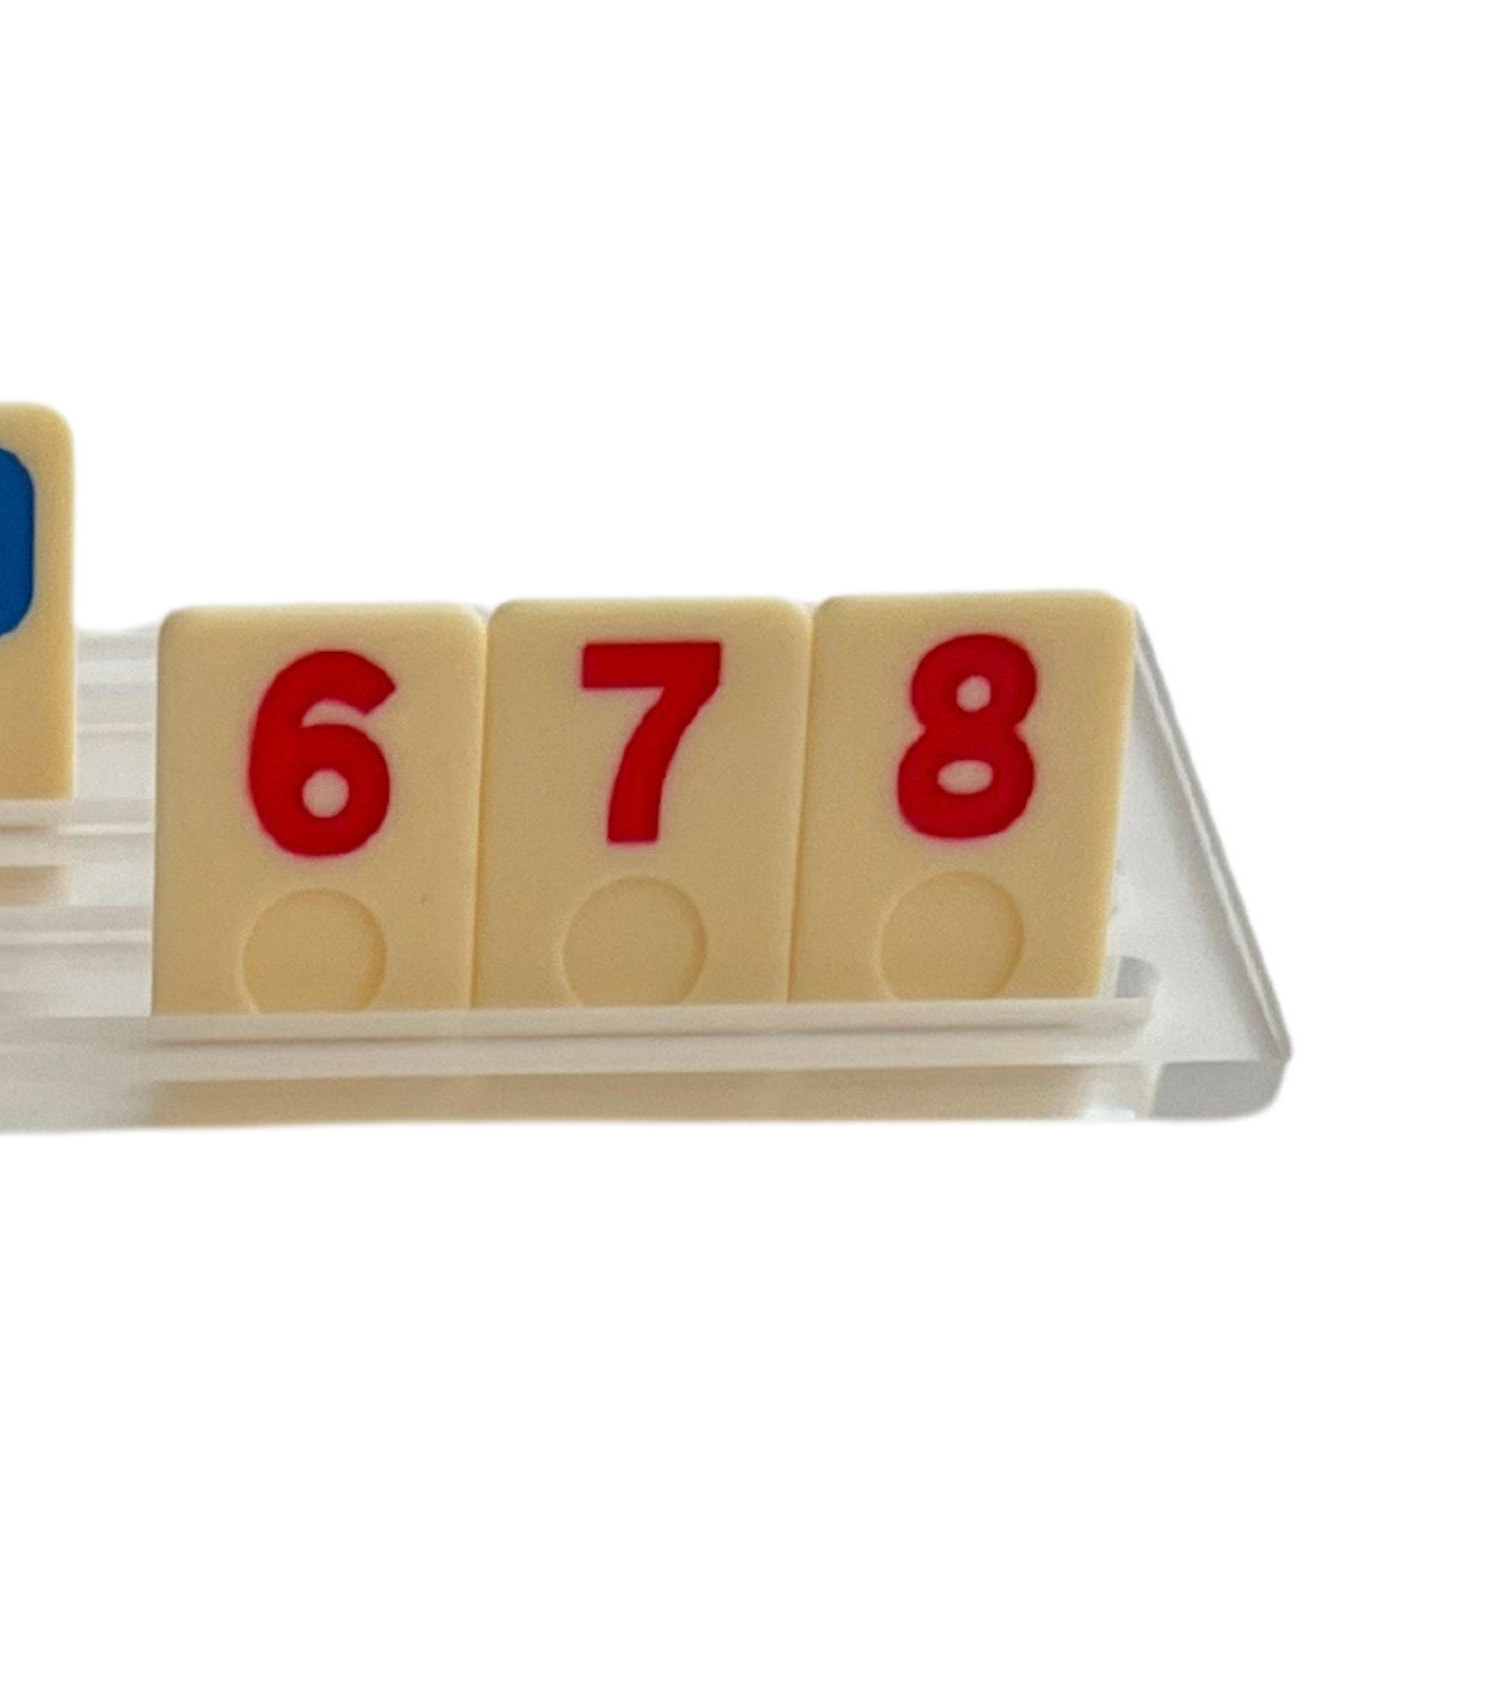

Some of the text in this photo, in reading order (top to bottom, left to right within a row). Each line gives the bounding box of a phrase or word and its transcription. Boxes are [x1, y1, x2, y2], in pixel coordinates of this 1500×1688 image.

[246, 649, 397, 859] 6
[580, 640, 725, 845] 7
[896, 632, 1040, 842] 8
